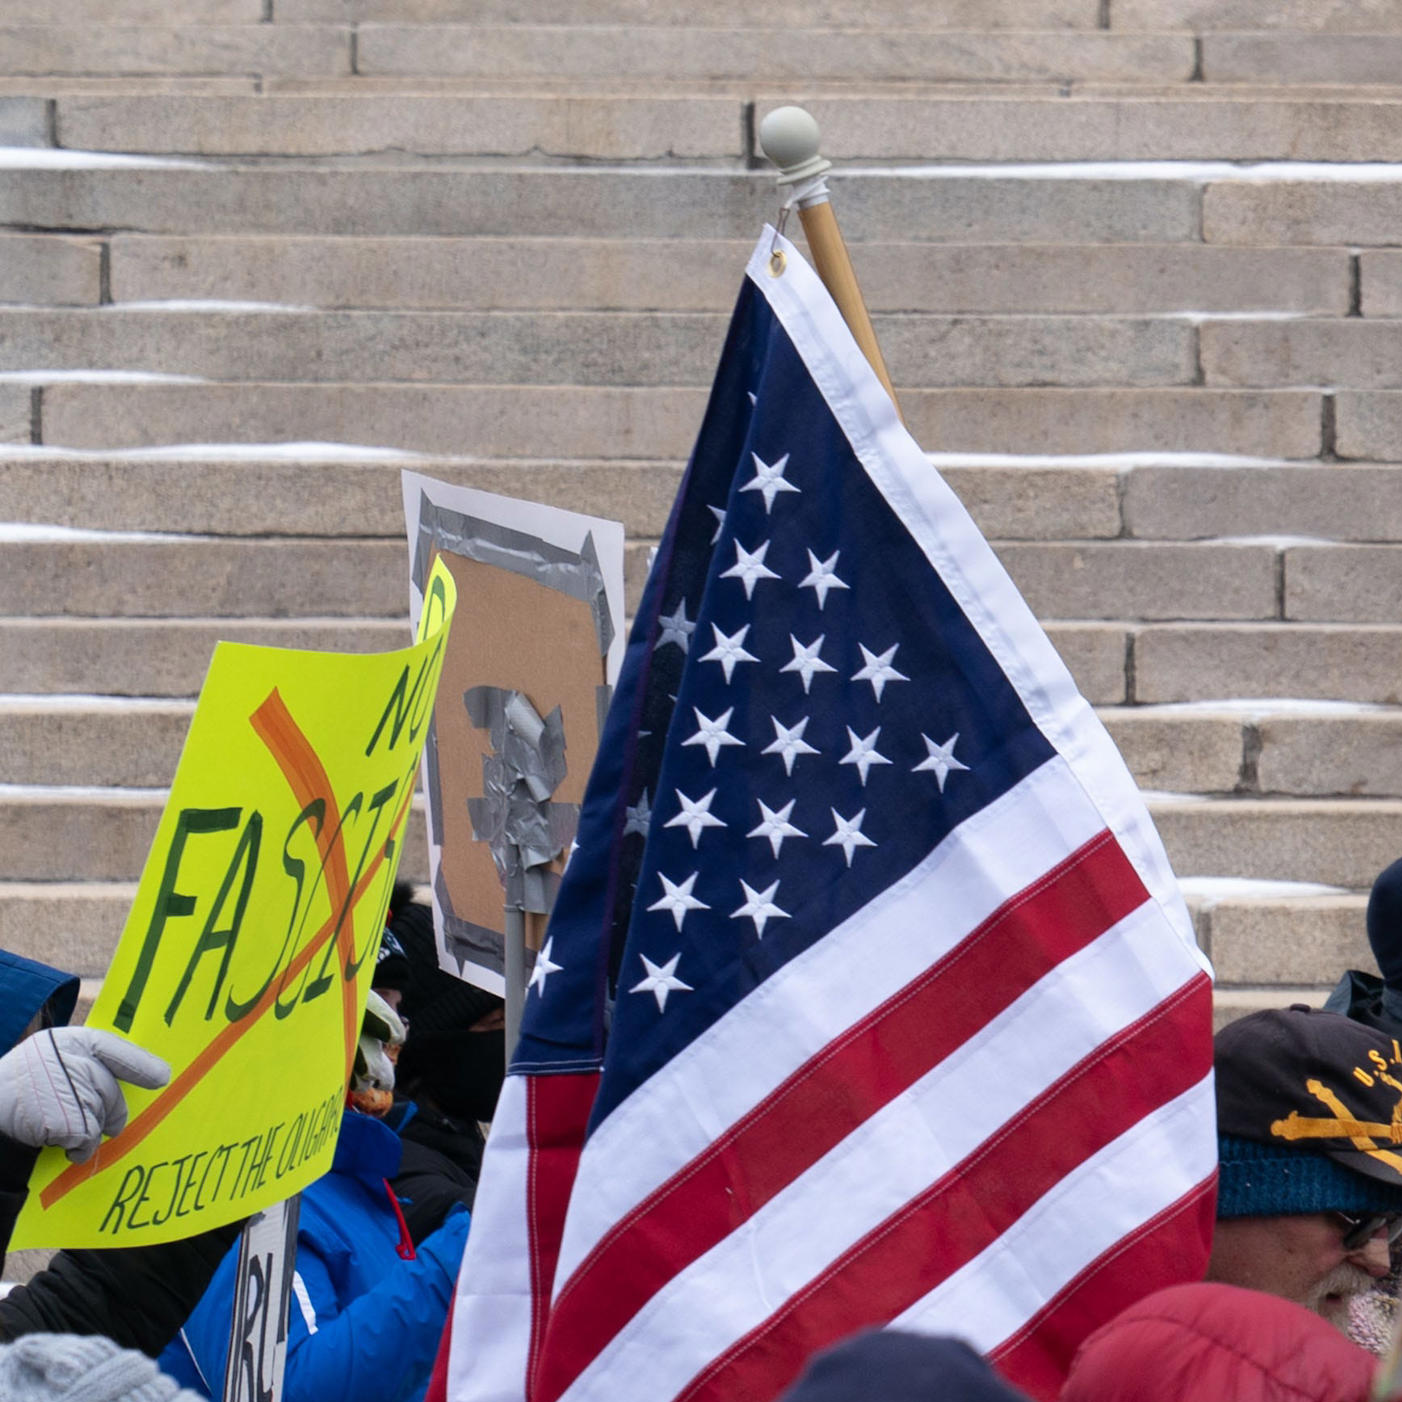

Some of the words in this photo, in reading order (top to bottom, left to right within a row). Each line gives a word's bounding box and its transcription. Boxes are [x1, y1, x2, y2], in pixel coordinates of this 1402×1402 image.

[365, 633, 444, 758] NO
[112, 751, 419, 1035] FASCIS
[98, 1143, 239, 1235] REJECT
[230, 1122, 286, 1201] THE
